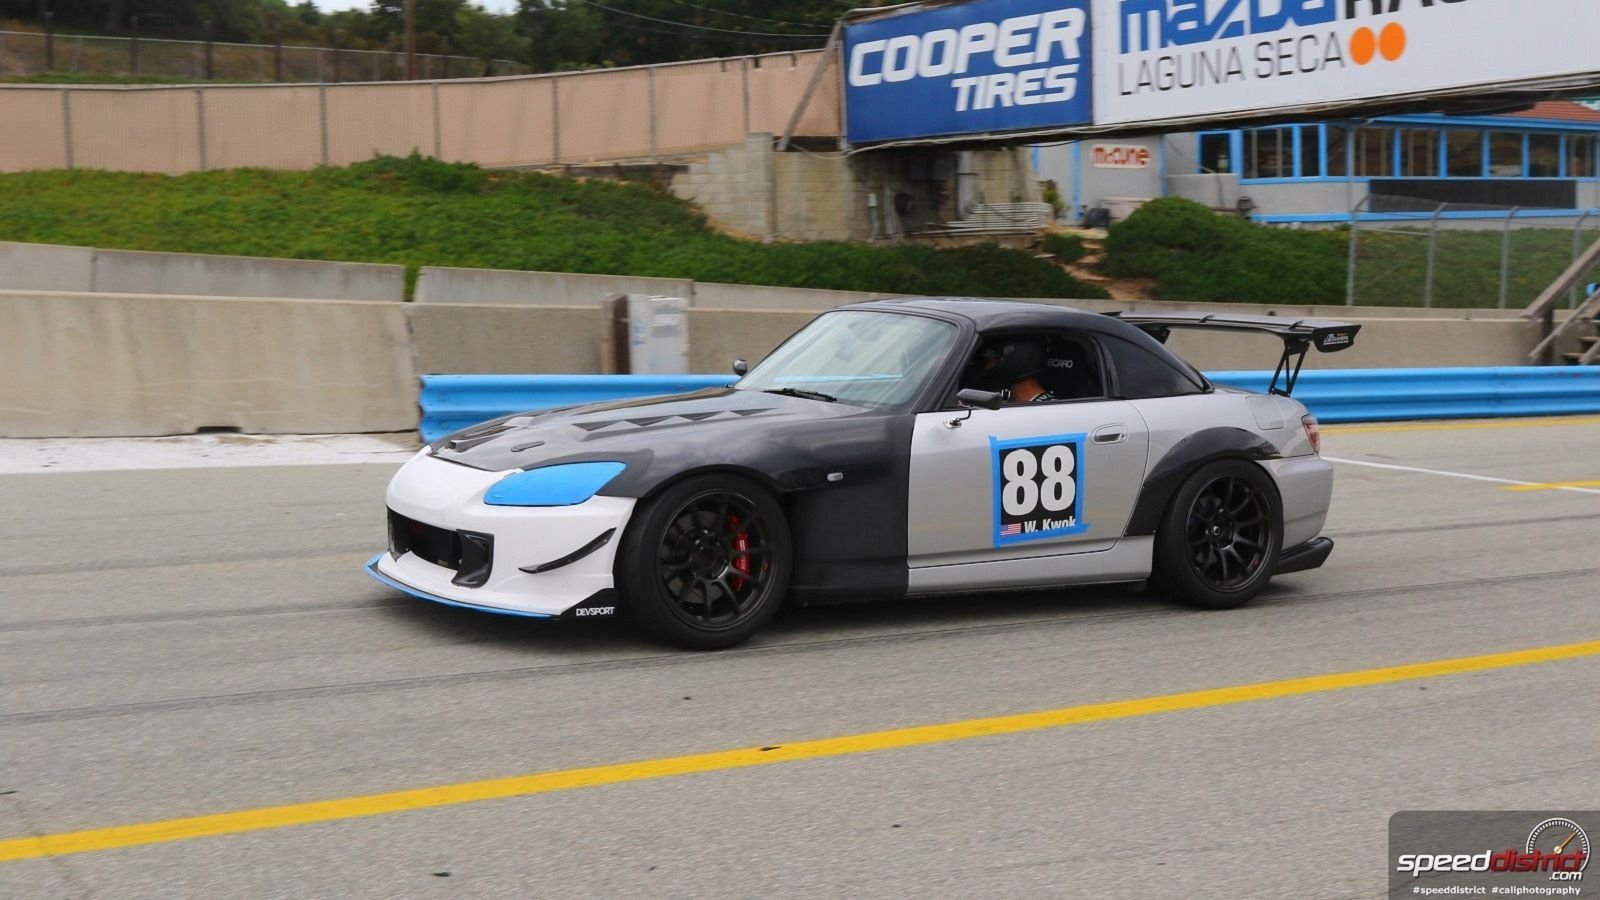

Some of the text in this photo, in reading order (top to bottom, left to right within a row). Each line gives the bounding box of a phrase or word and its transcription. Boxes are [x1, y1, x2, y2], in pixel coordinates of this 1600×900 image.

[849, 8, 1086, 87] COOPER
[1118, 31, 1346, 96] LAGUNA SECA
[951, 63, 1080, 112] TIRES
[1002, 445, 1076, 516] 88
[1023, 515, 1076, 534] W. Kwok
[576, 606, 615, 617] DEVSPORT
